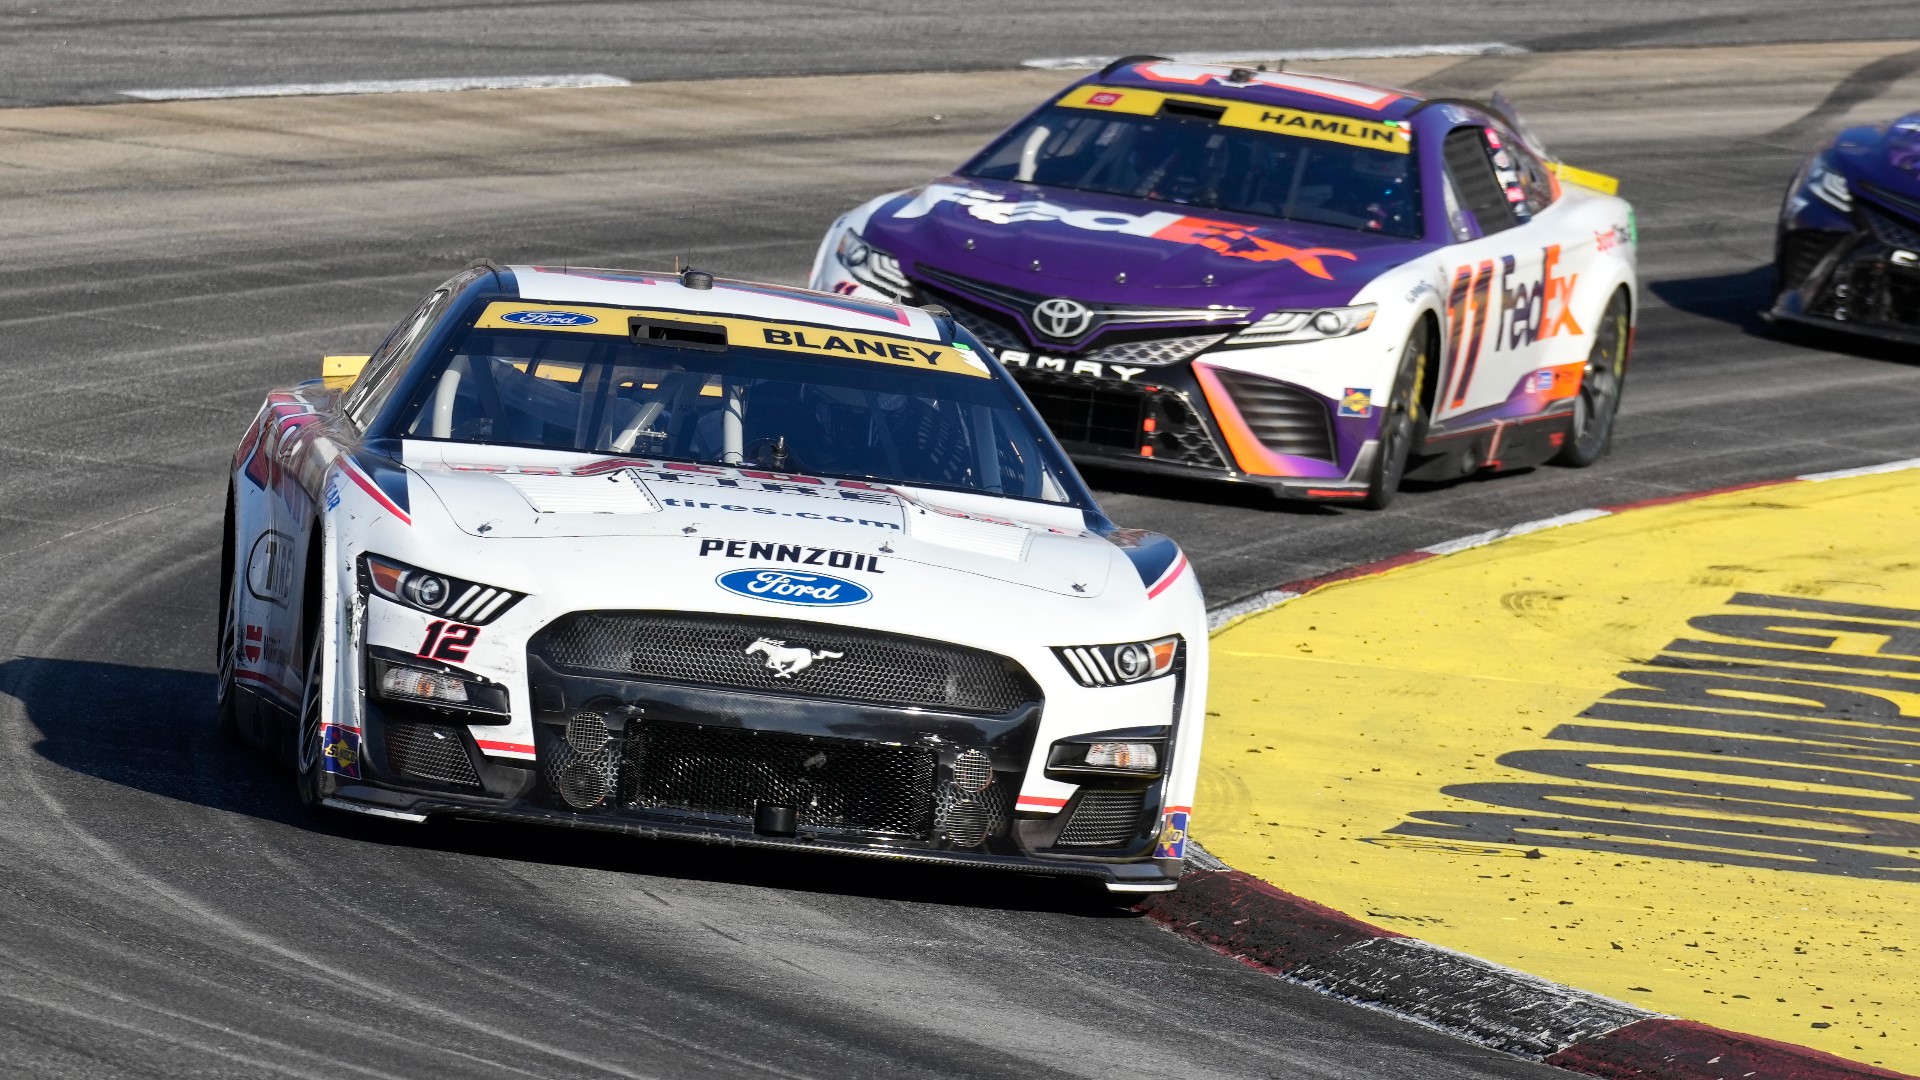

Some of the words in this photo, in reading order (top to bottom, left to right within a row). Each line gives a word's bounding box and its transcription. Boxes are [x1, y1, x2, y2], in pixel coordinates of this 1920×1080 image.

[1260, 110, 1395, 145] HAMLIN
[893, 184, 1357, 281] FedEx
[1495, 243, 1583, 352] FedEx
[519, 310, 580, 327] Ford
[762, 328, 943, 367] BLANEY
[1438, 259, 1494, 414] 11
[986, 347, 1147, 382] AMRY
[661, 497, 901, 532] tires.com
[699, 539, 886, 574] PENNZOIL
[747, 571, 840, 602] Ford
[417, 619, 481, 664] 12
